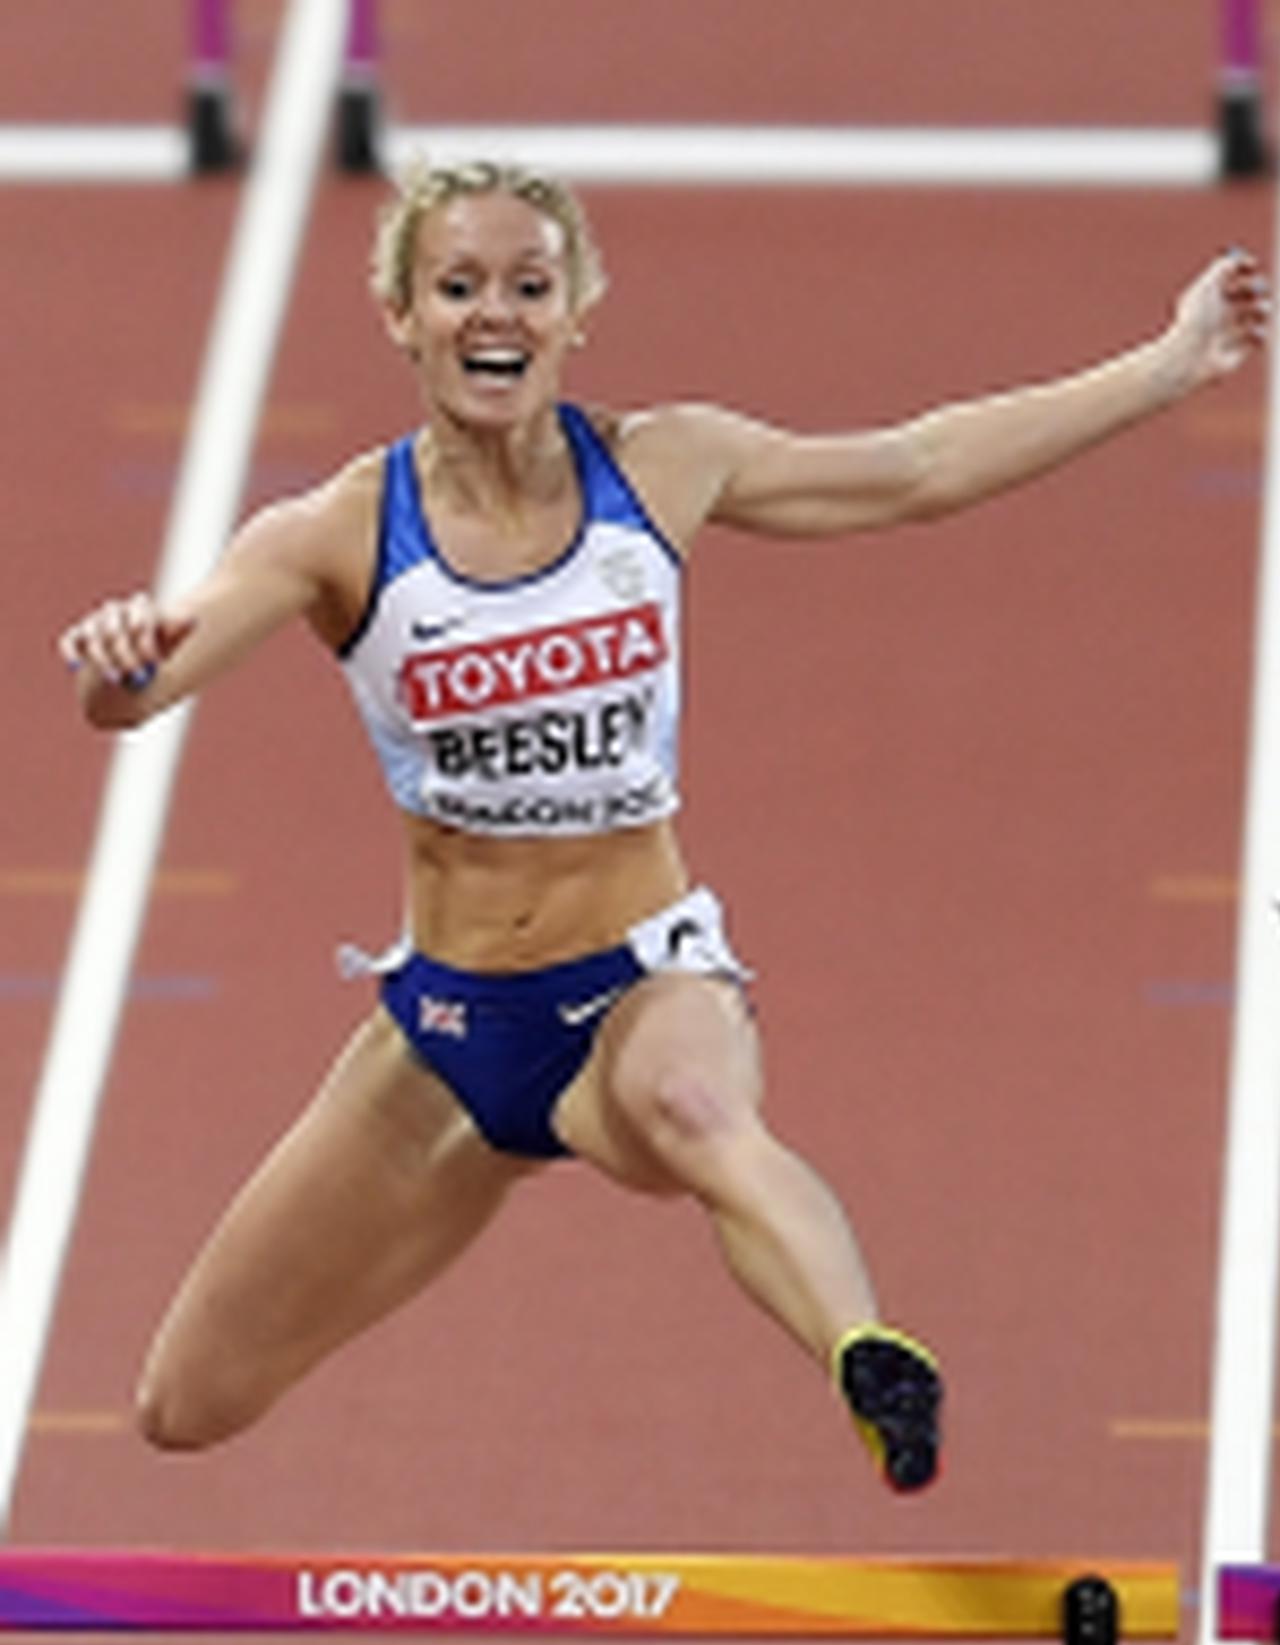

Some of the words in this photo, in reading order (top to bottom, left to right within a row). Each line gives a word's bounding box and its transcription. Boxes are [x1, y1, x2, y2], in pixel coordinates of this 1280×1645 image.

[411, 617, 659, 709] TOYOTA
[298, 1571, 542, 1618] LONDON
[550, 1571, 681, 1618] 2017
